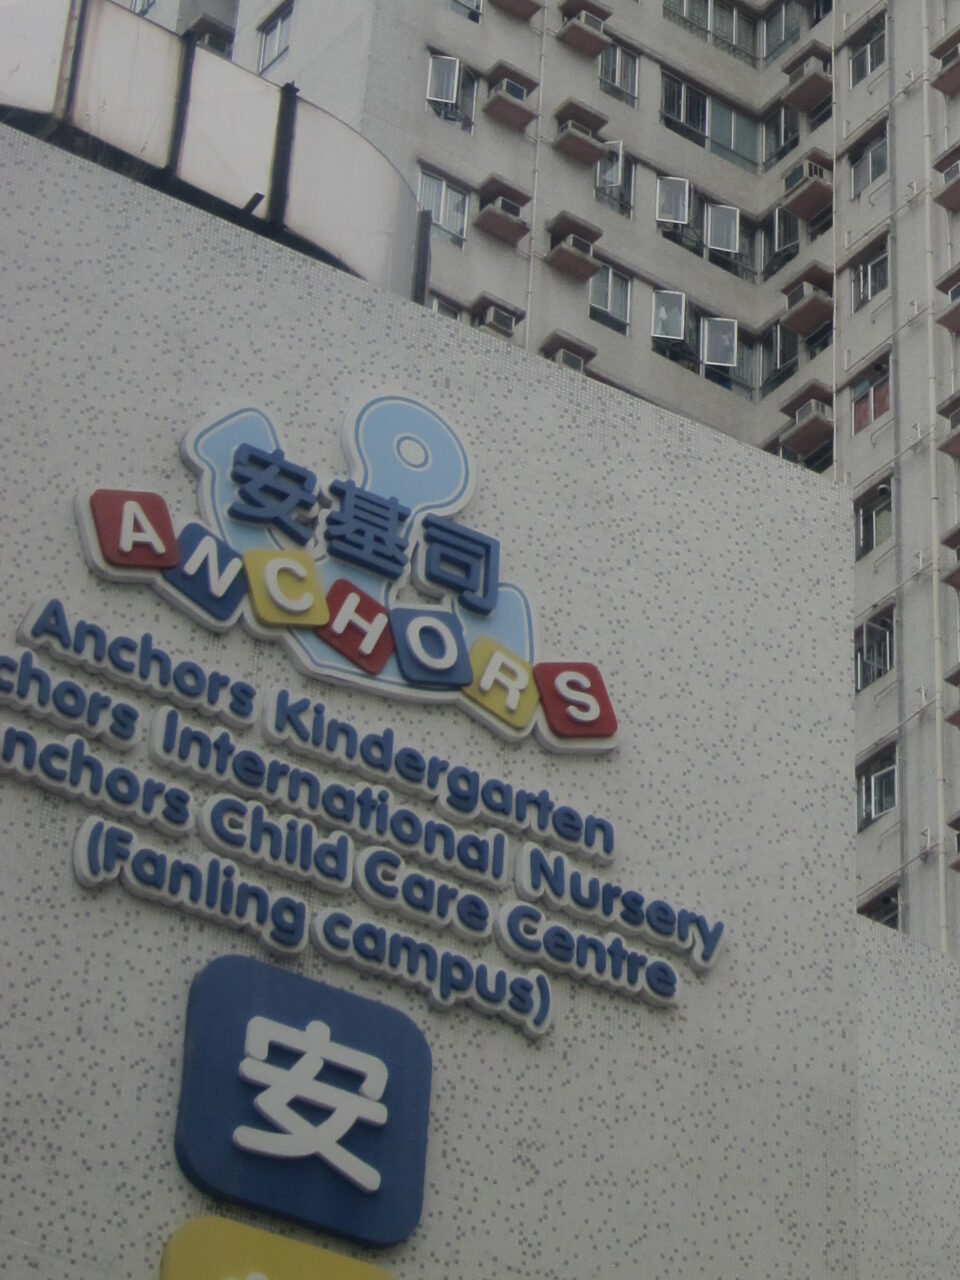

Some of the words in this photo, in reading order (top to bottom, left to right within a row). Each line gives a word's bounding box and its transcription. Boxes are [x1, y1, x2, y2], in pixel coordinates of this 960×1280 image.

[118, 500, 600, 721] ANCHORS
[228, 443, 500, 616] 安基司
[32, 599, 256, 717] Anchors
[275, 689, 614, 854] Kindergarten
[88, 821, 306, 946] (Fanling
[323, 913, 551, 1025] campus)
[164, 710, 505, 878] International
[529, 847, 724, 962] Nursery
[210, 798, 349, 881] Child
[365, 851, 490, 931] Care
[507, 905, 677, 997] Centre
[233, 1016, 389, 1194] 安
